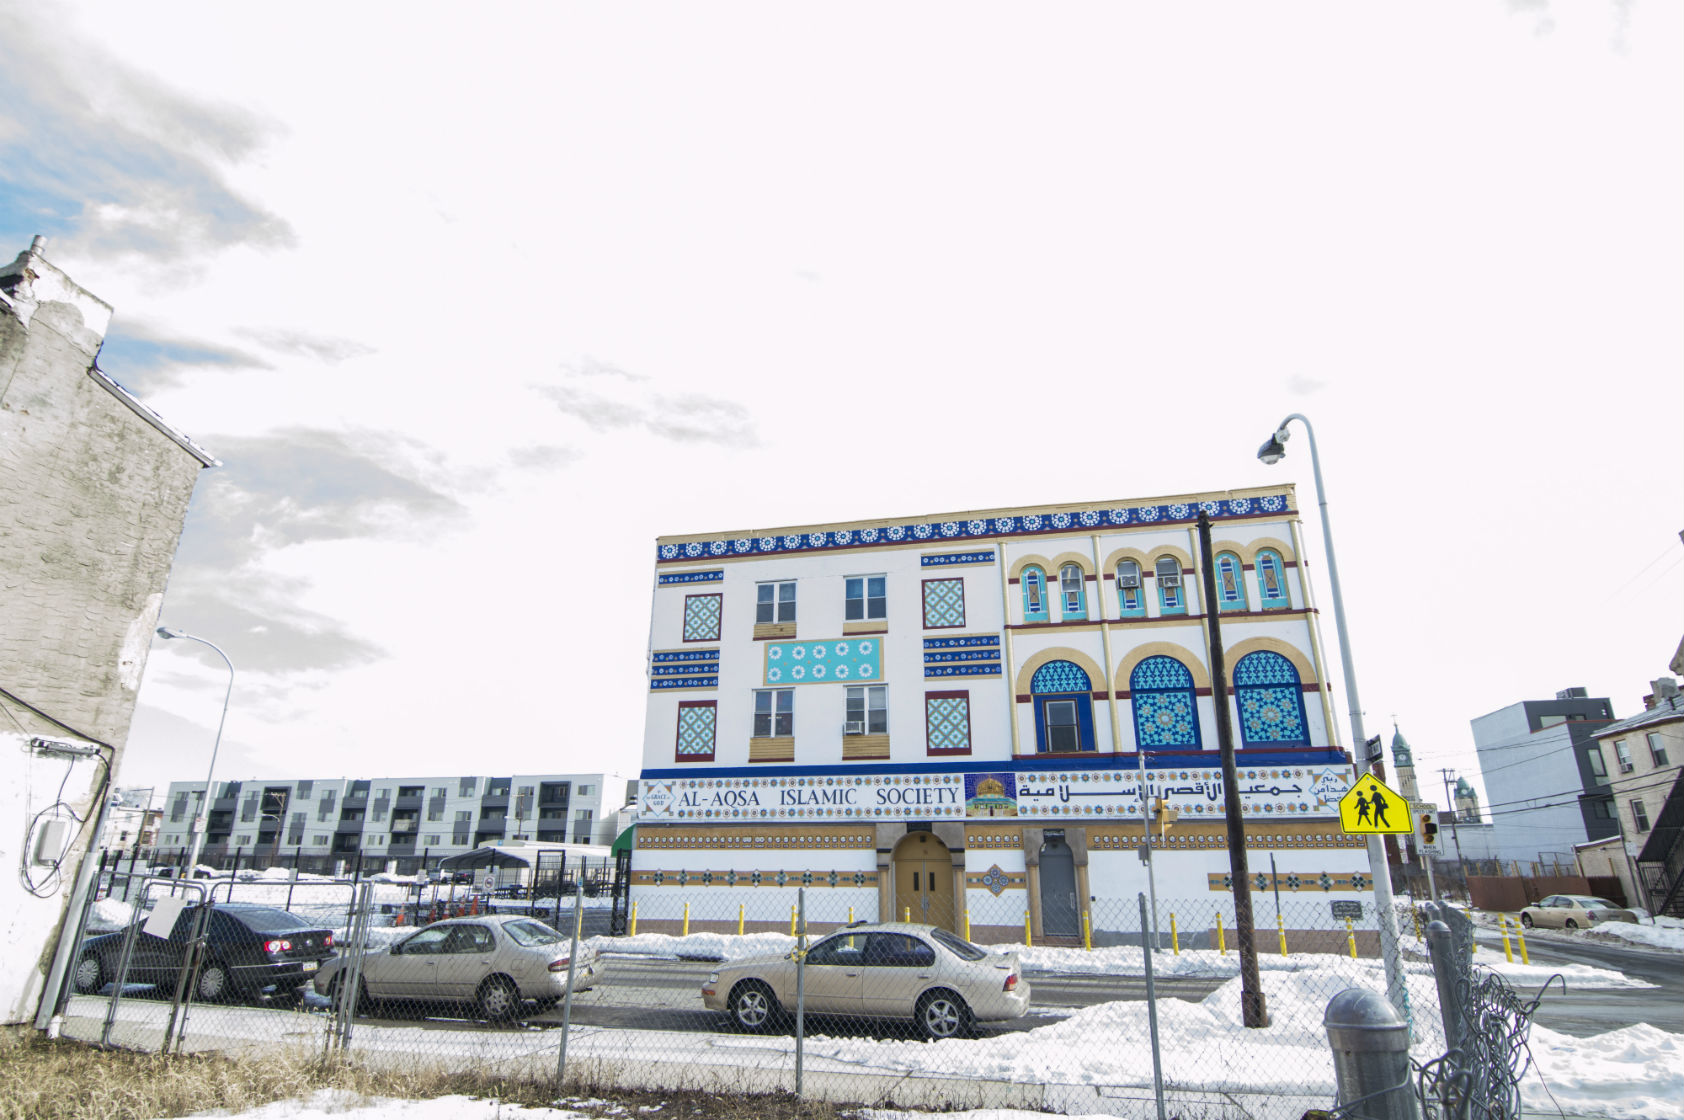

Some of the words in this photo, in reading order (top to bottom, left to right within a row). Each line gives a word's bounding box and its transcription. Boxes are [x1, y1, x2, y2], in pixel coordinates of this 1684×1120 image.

[678, 789, 760, 808] AL-AQSA
[780, 788, 857, 806] ISLAMIC
[876, 787, 959, 805] SOCIETY
[1237, 784, 1302, 799] جمعي
